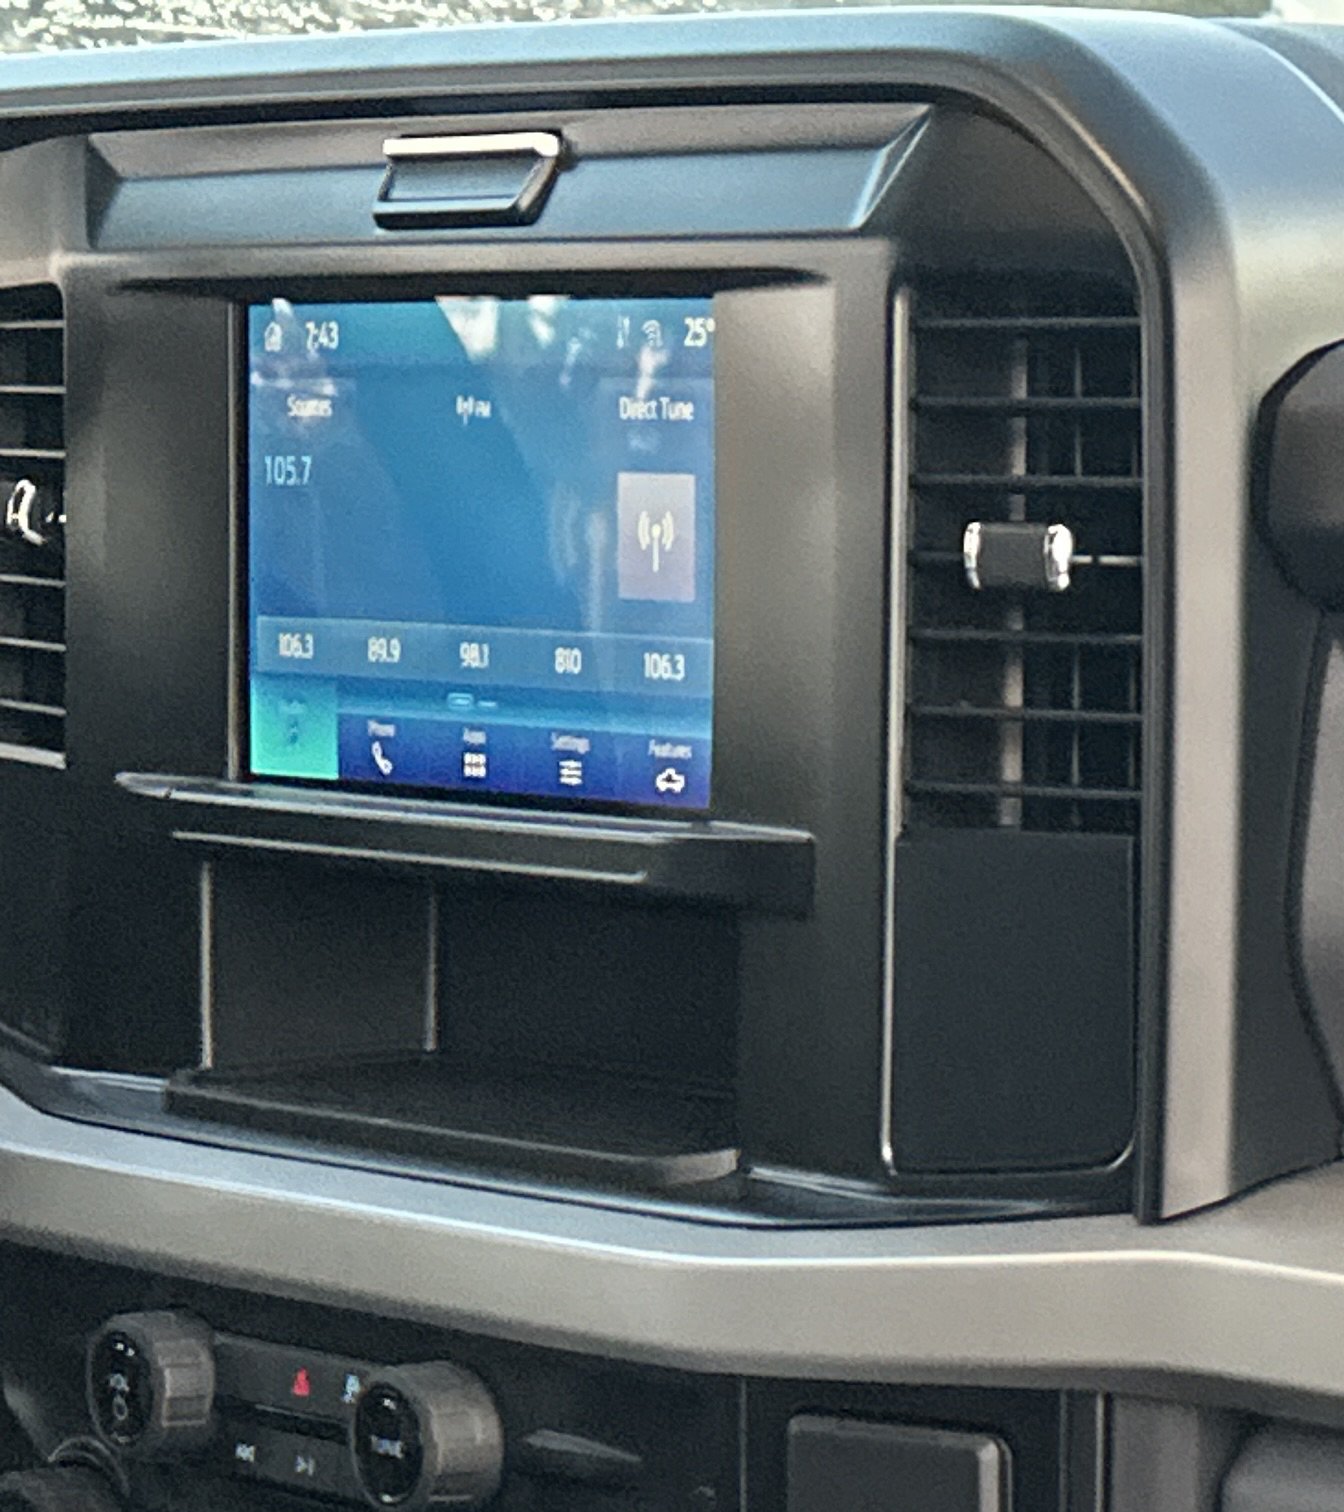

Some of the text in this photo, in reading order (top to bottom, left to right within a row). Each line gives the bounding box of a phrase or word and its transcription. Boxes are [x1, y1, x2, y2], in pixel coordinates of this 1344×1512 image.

[619, 396, 694, 421] Direct Tune
[264, 455, 312, 485] 105.7
[279, 633, 314, 659] 106.3
[368, 636, 401, 663] 89.9
[460, 641, 490, 669] 98.1
[643, 652, 685, 681] 106.3
